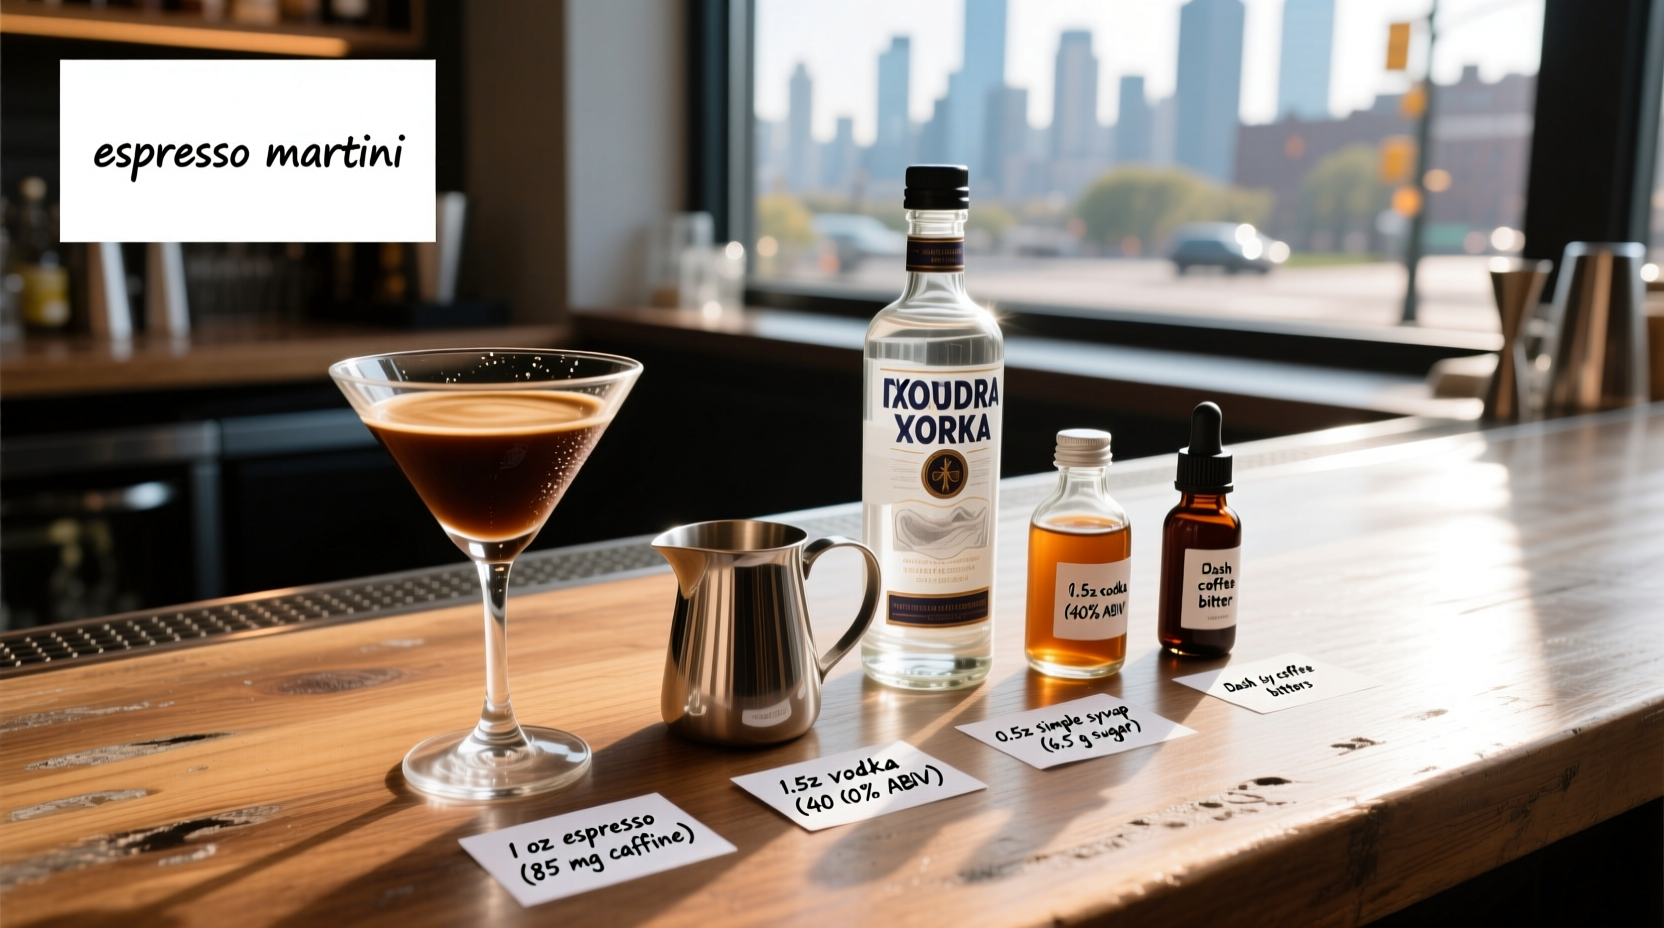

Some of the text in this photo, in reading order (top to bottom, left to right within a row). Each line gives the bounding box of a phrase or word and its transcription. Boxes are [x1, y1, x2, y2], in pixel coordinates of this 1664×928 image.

[894, 413, 991, 445] XORKA
[1202, 561, 1232, 575] Dash
[1198, 594, 1234, 609] bitter
[1223, 677, 1258, 693] Dash
[995, 726, 1034, 743] 0.5z
[1036, 714, 1084, 733] simple
[1040, 719, 1141, 753] (6.5 g sugar)
[779, 757, 900, 795] 1.5z vodka
[795, 794, 834, 816] (40
[527, 837, 554, 854] oz
[562, 814, 655, 849] espresso
[520, 822, 695, 886] (85 mg caffine)
